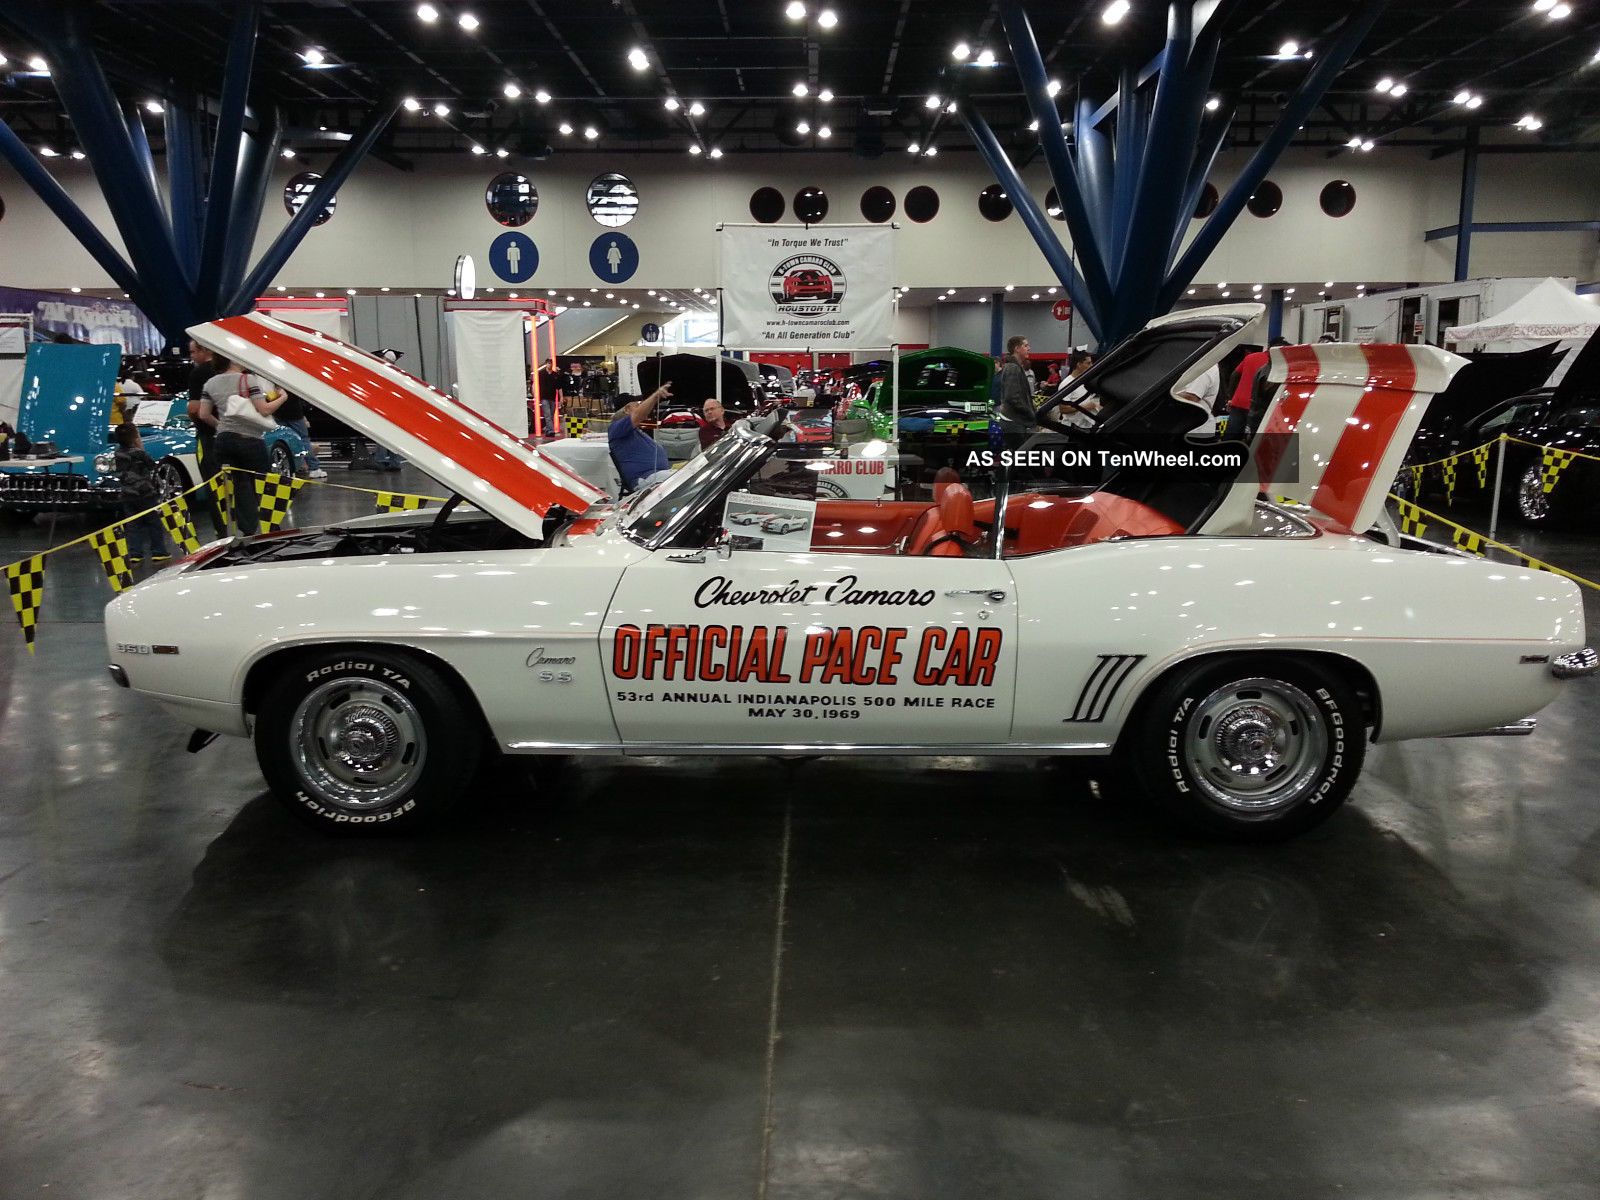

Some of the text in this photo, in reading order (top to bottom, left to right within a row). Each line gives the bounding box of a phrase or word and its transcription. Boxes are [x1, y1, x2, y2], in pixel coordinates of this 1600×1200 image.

[783, 238, 807, 248] Torque
[810, 239, 822, 247] We
[823, 238, 849, 247] Trust"
[800, 256, 824, 265] CAMARO
[823, 261, 837, 274] CLUB
[777, 331, 788, 339] All
[790, 330, 831, 339] Generation
[833, 330, 855, 339] Club"
[855, 460, 885, 475] CLUB
[694, 575, 936, 608] Chevrolet Camaro
[526, 647, 576, 668] Camaro
[612, 623, 1003, 687] OFFICIAL PACE CAR
[306, 661, 411, 689] Radial T/A
[616, 691, 995, 709] 53rd ANNUAL INDIANAPOLIS 500 MILE RACE
[748, 708, 786, 718] MAY
[1168, 697, 1194, 793] T/A Radial
[1309, 687, 1345, 805] BFGoodrich
[295, 791, 417, 823] BFGoodrich
